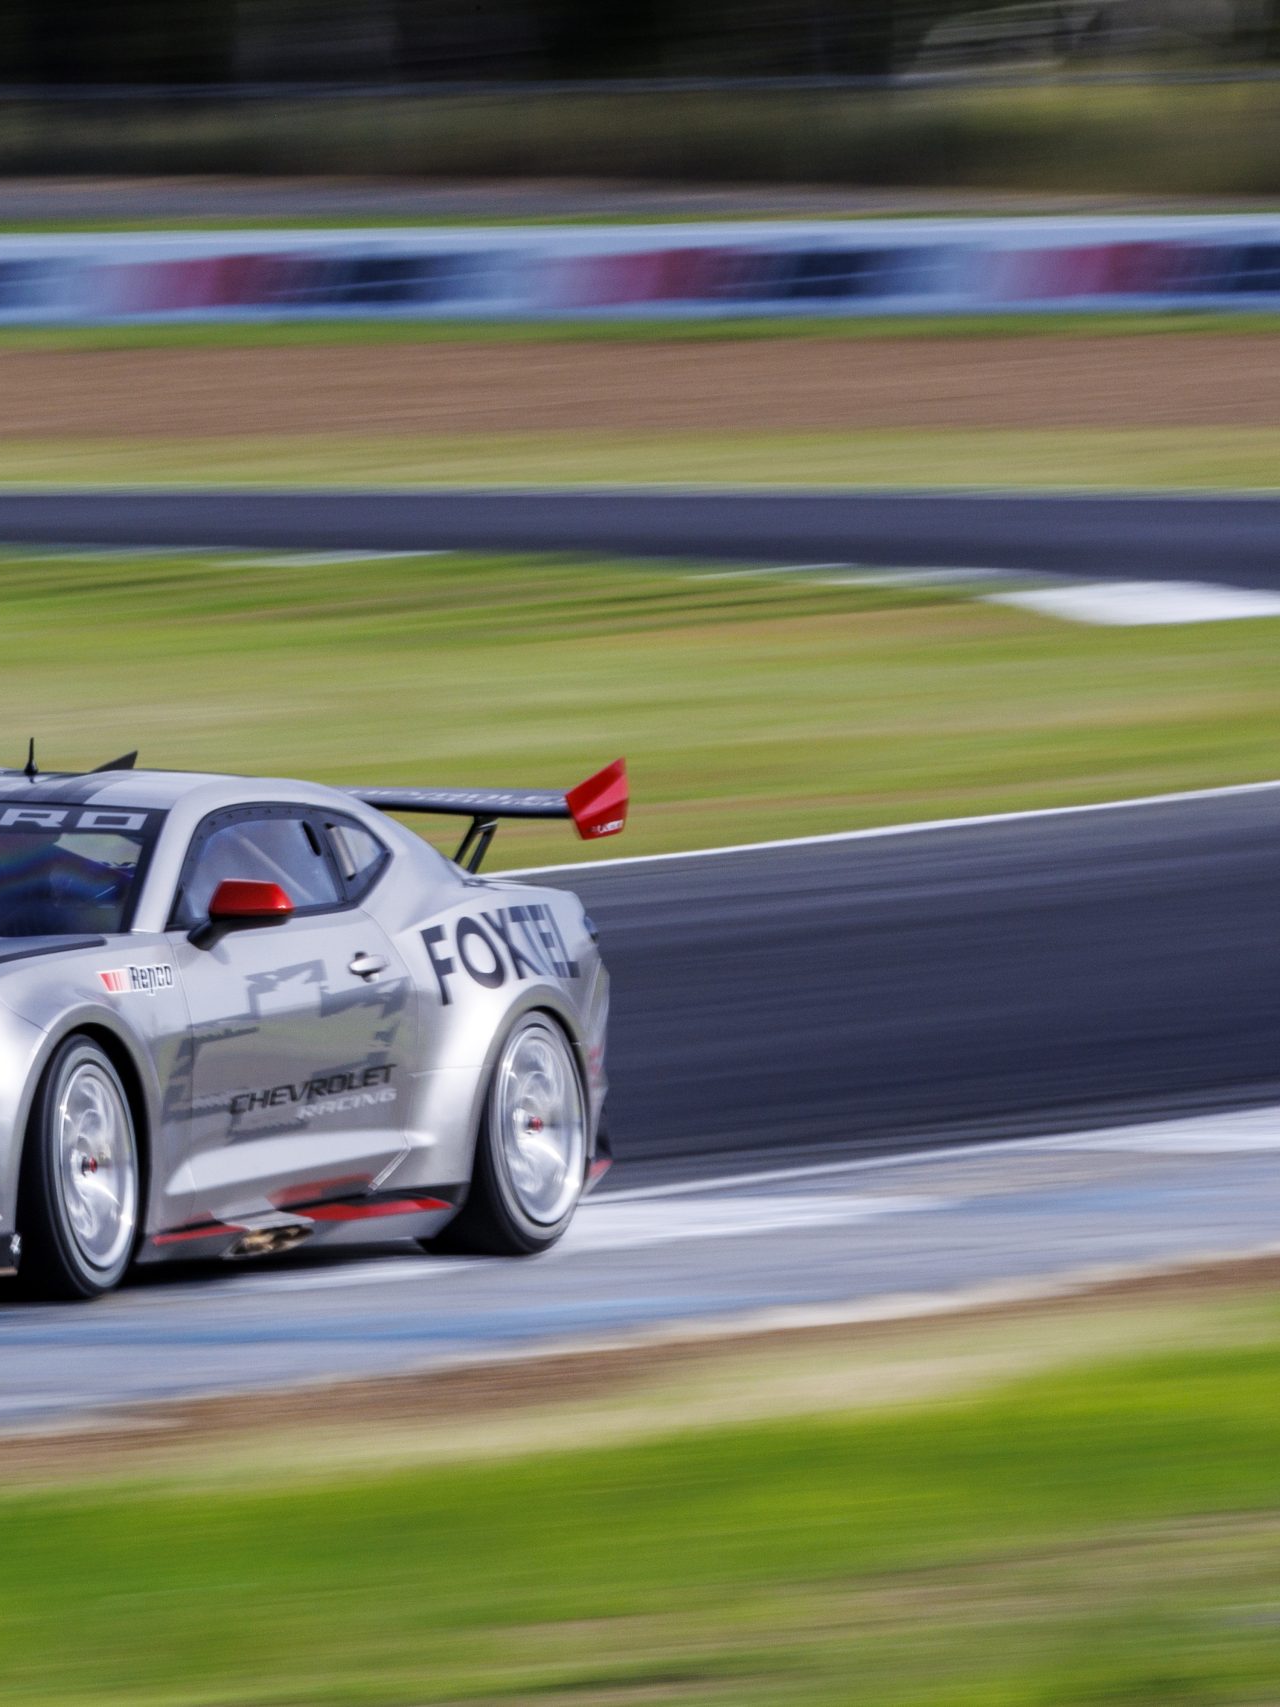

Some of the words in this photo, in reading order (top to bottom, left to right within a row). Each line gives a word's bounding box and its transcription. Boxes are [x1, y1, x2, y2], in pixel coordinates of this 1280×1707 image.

[420, 904, 580, 1006] FOXTEL
[128, 965, 173, 994] Repco
[229, 1063, 397, 1115] CHEVROLET
[296, 1088, 397, 1119] RACING
